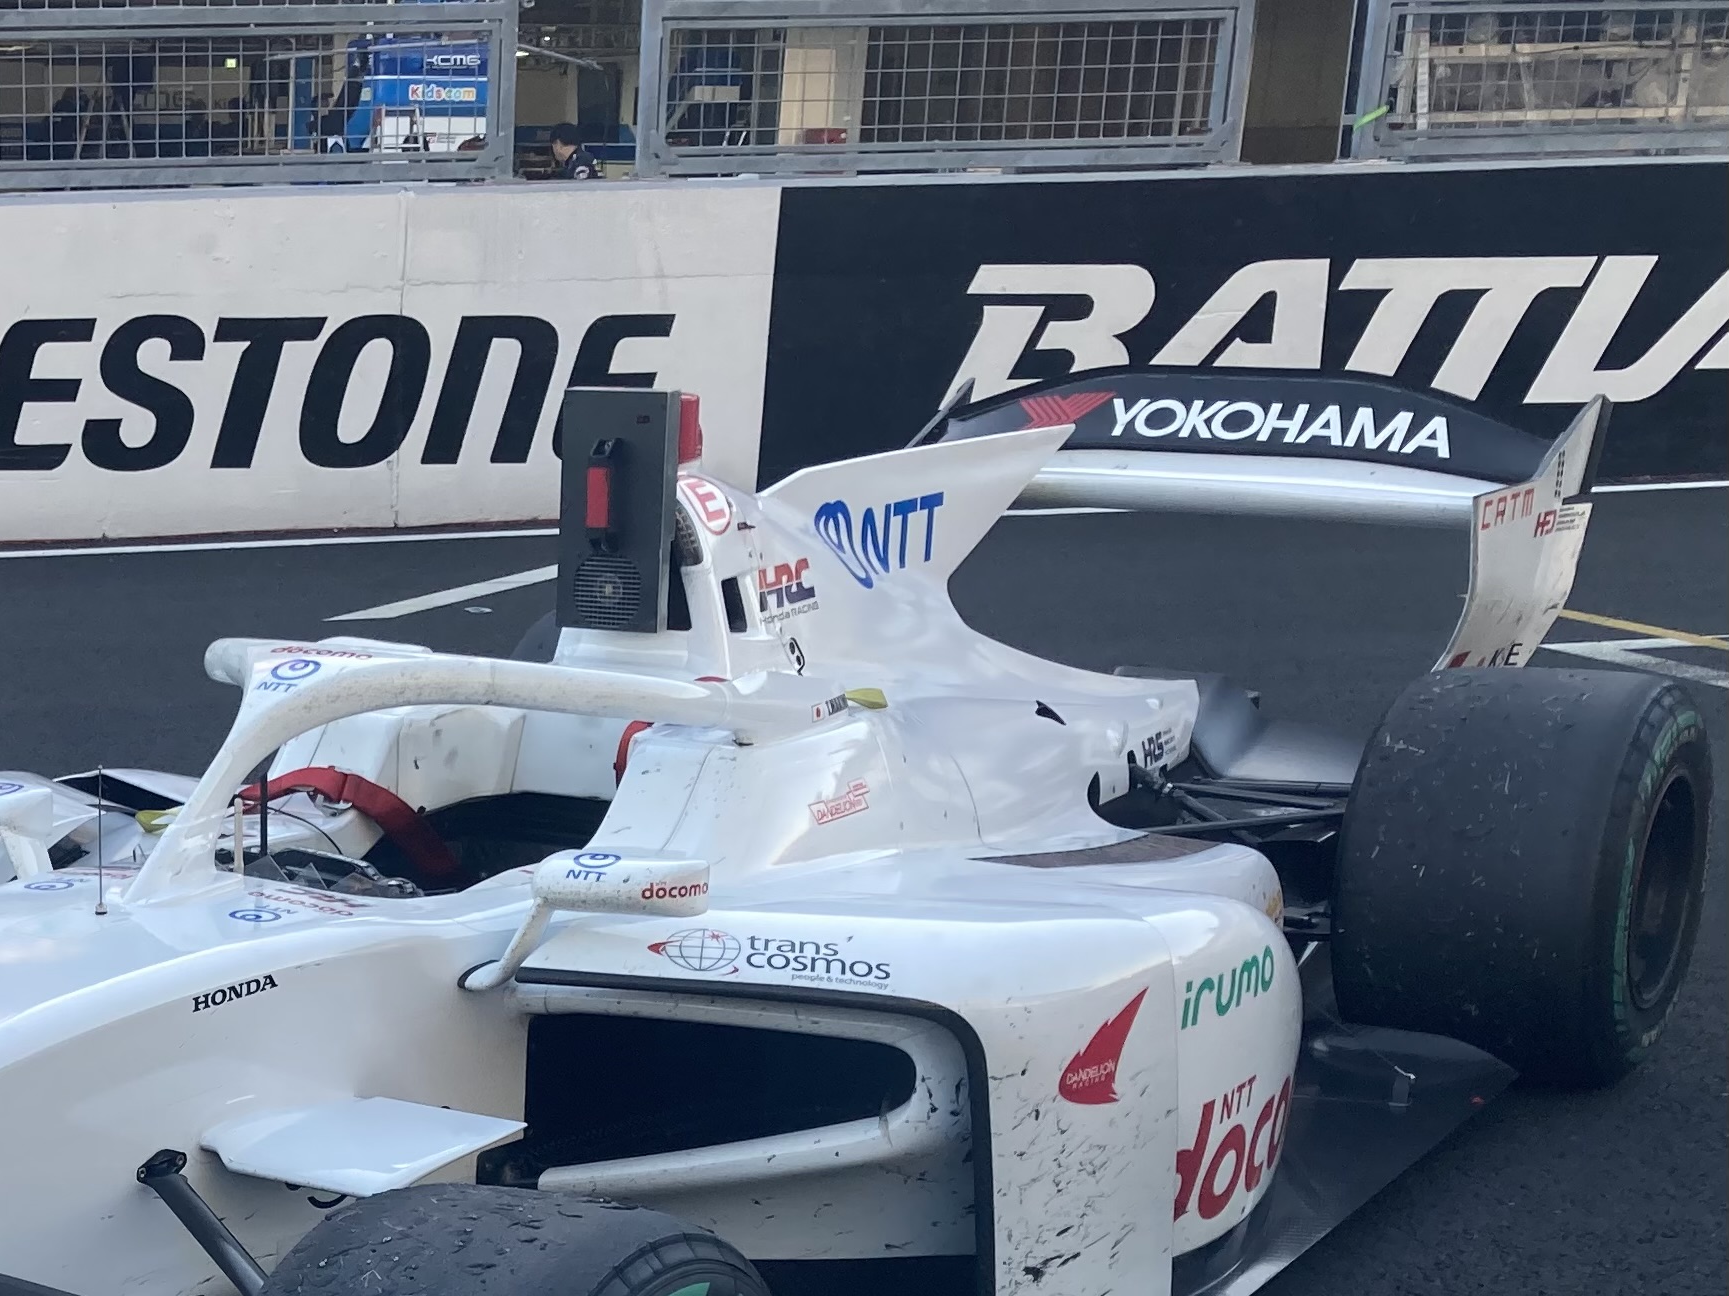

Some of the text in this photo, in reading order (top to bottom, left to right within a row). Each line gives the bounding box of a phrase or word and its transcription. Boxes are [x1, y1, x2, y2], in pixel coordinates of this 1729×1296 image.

[1111, 397, 1451, 459] YOKOHAMA
[862, 491, 945, 574] NTT
[271, 645, 373, 660] docomo
[256, 681, 298, 693] NTT
[565, 869, 608, 882] NTT
[641, 882, 709, 900] docomo
[747, 935, 839, 957] trans
[746, 952, 891, 980] cosmos
[192, 974, 278, 1013] HONDA
[791, 973, 825, 982] people
[835, 976, 889, 991] technology
[1181, 945, 1274, 1030] irumo
[1066, 1059, 1117, 1085] DANDELION
[1220, 1074, 1257, 1124] NTT
